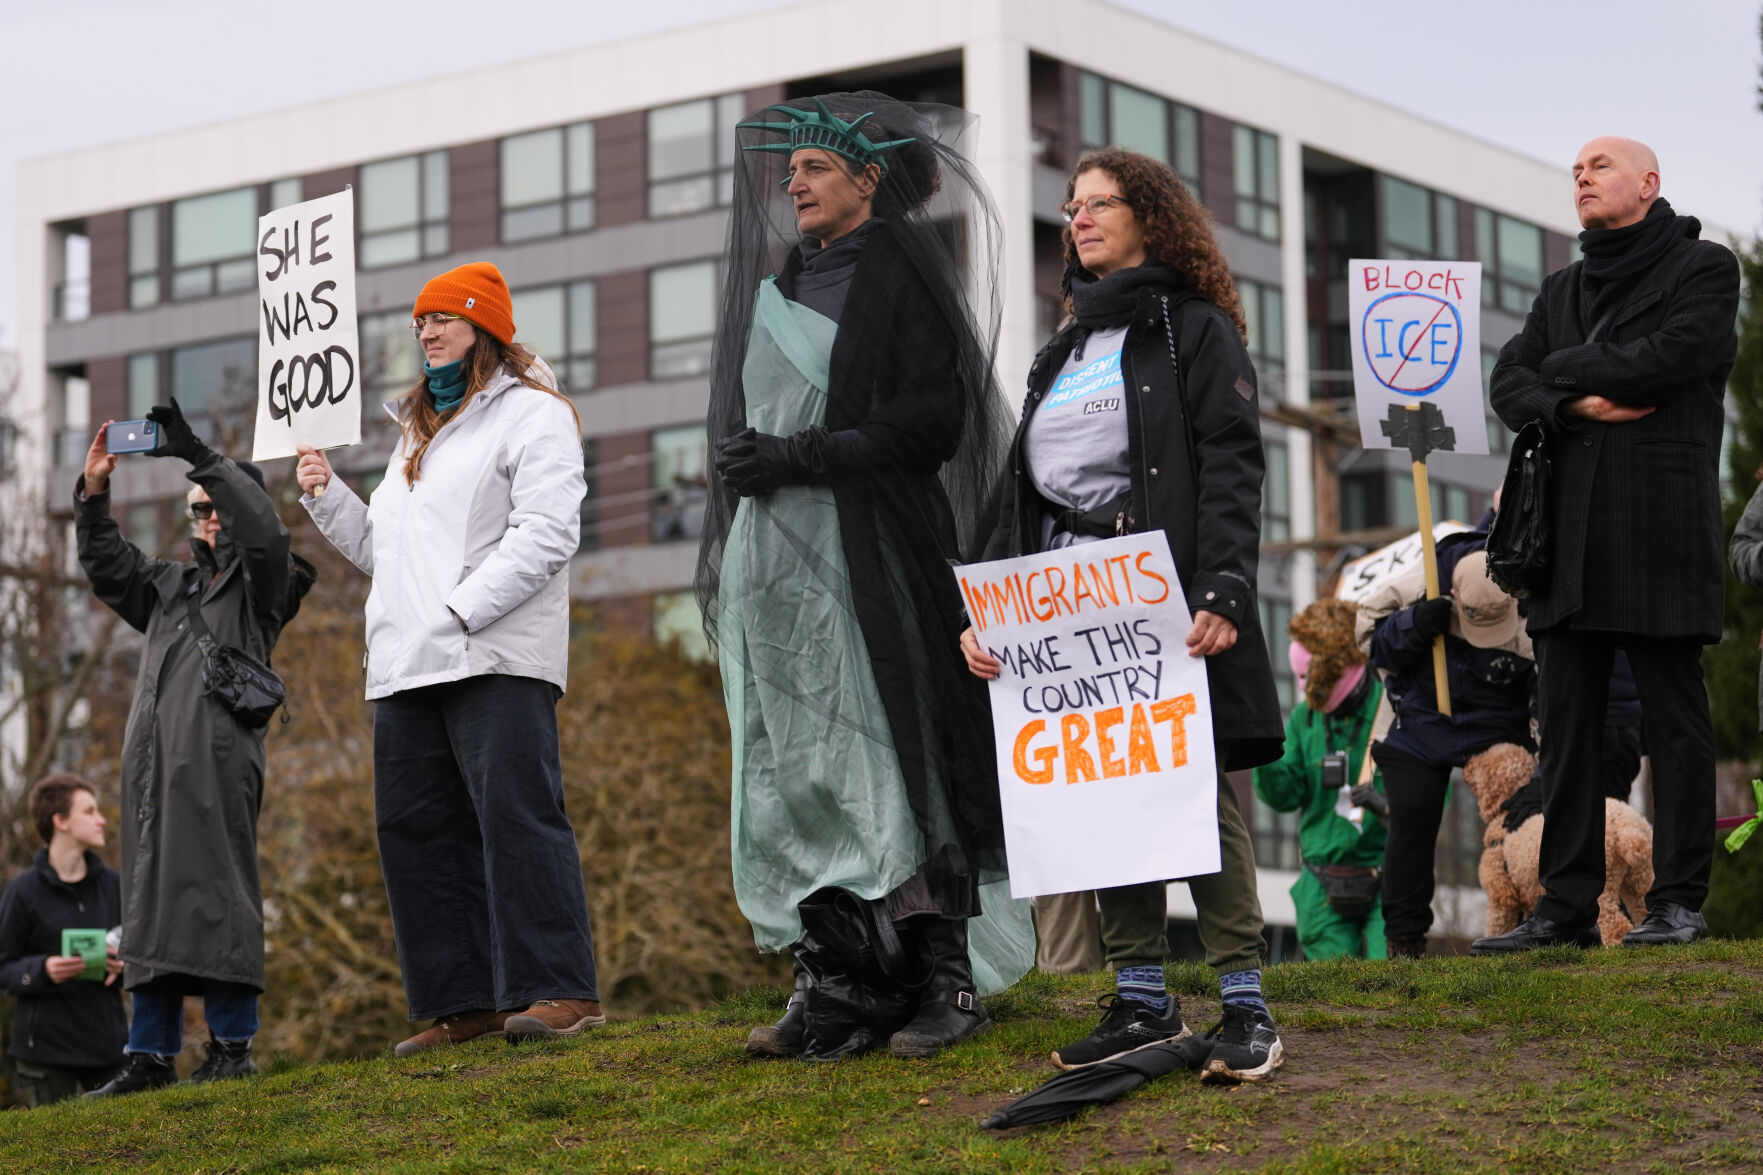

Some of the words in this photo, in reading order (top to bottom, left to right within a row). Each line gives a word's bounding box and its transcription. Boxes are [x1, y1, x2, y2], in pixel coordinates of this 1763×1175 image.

[260, 213, 333, 281] SHE
[1363, 265, 1464, 299] BLOCK
[262, 280, 339, 346] WAS
[1373, 318, 1452, 365] ICE
[268, 345, 354, 427] GOOD
[1084, 399, 1119, 415] ACLU
[960, 551, 1170, 632] IMMIGRANTS
[1353, 542, 1424, 592] SK
[988, 635, 1072, 679] MAKE
[1074, 619, 1162, 666] THIS
[1022, 660, 1163, 714] COUNTRY
[1012, 692, 1198, 785] GREAT
